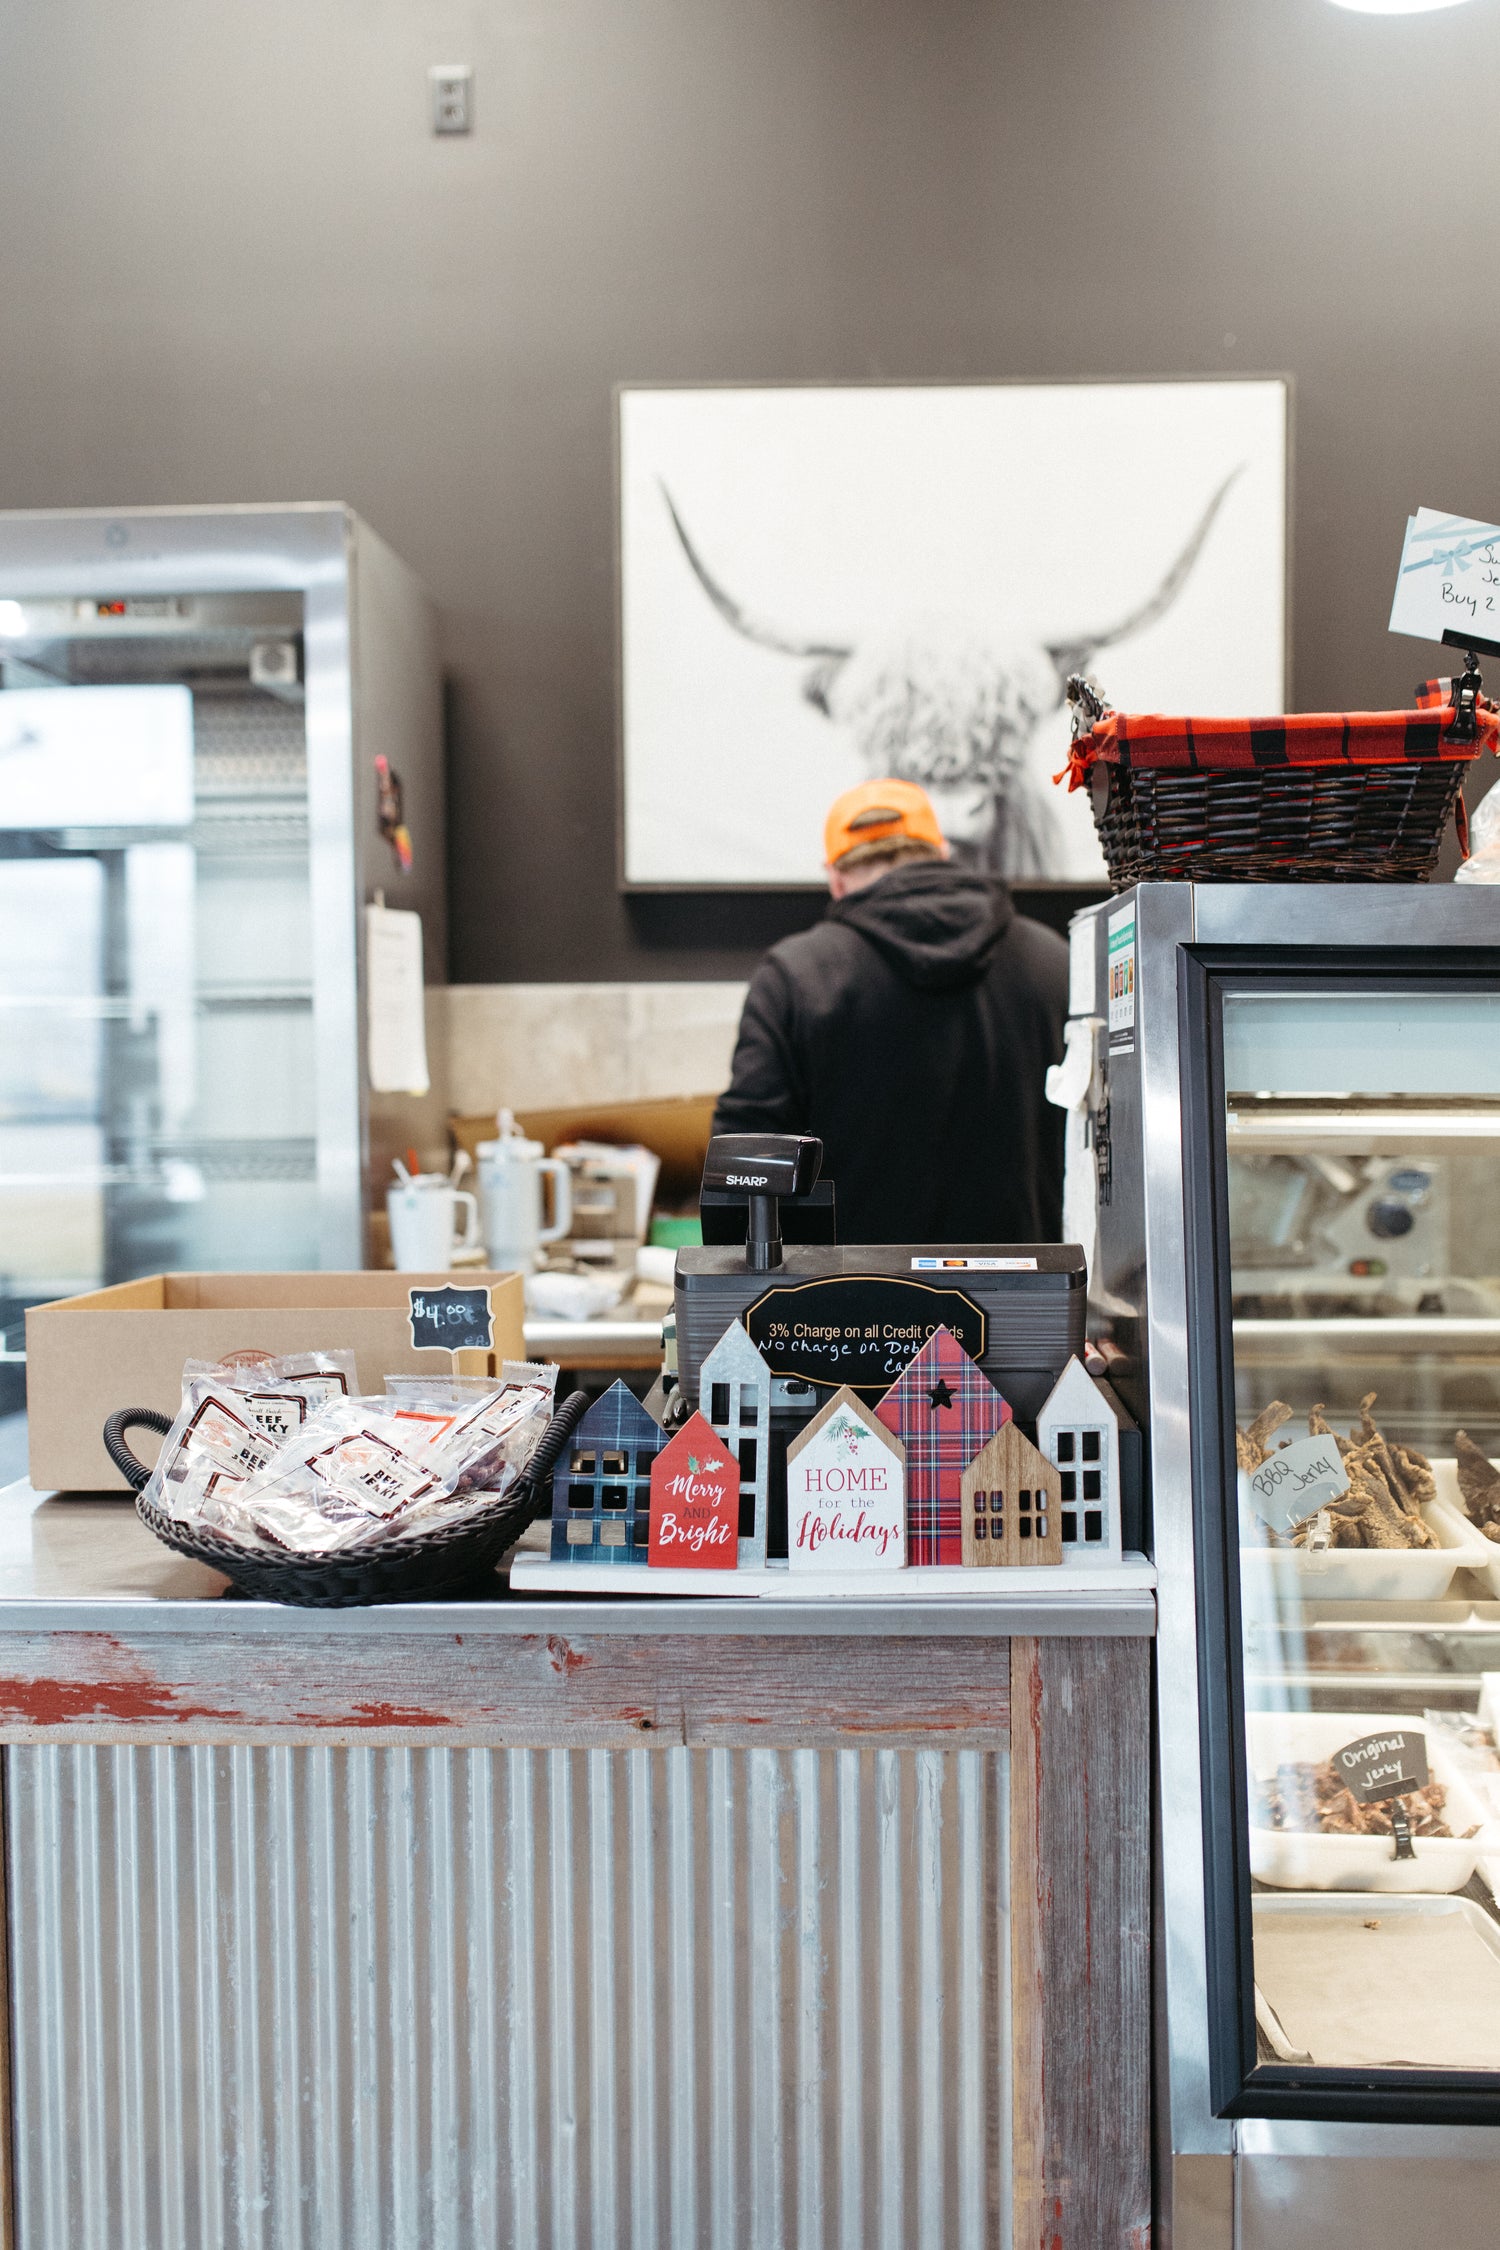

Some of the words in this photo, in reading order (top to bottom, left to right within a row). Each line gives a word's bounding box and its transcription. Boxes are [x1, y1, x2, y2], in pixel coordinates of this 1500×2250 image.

[1442, 583, 1477, 616] Buy
[1486, 597, 1495, 611] 2
[726, 1175, 768, 1186] SHARP
[769, 1323, 790, 1337] 3%
[794, 1323, 840, 1341] Charge
[844, 1327, 860, 1338] on
[864, 1324, 879, 1338] all
[883, 1324, 921, 1338] Credit
[925, 1325, 964, 1339] Cds
[860, 1343, 880, 1354] on
[884, 1341, 923, 1354] Deb
[255, 1415, 282, 1424] EEF
[240, 1448, 267, 1470] BEE
[805, 1467, 887, 1492] HOME
[1252, 1460, 1294, 1497] BBQ
[1293, 1456, 1338, 1491] Jerky
[664, 1474, 726, 1507] Merry
[683, 1507, 711, 1518] AND
[819, 1497, 841, 1508] for
[851, 1497, 875, 1508] the
[659, 1513, 732, 1552] Bright
[796, 1511, 904, 1556] Holidays
[1341, 1734, 1405, 1768] Original
